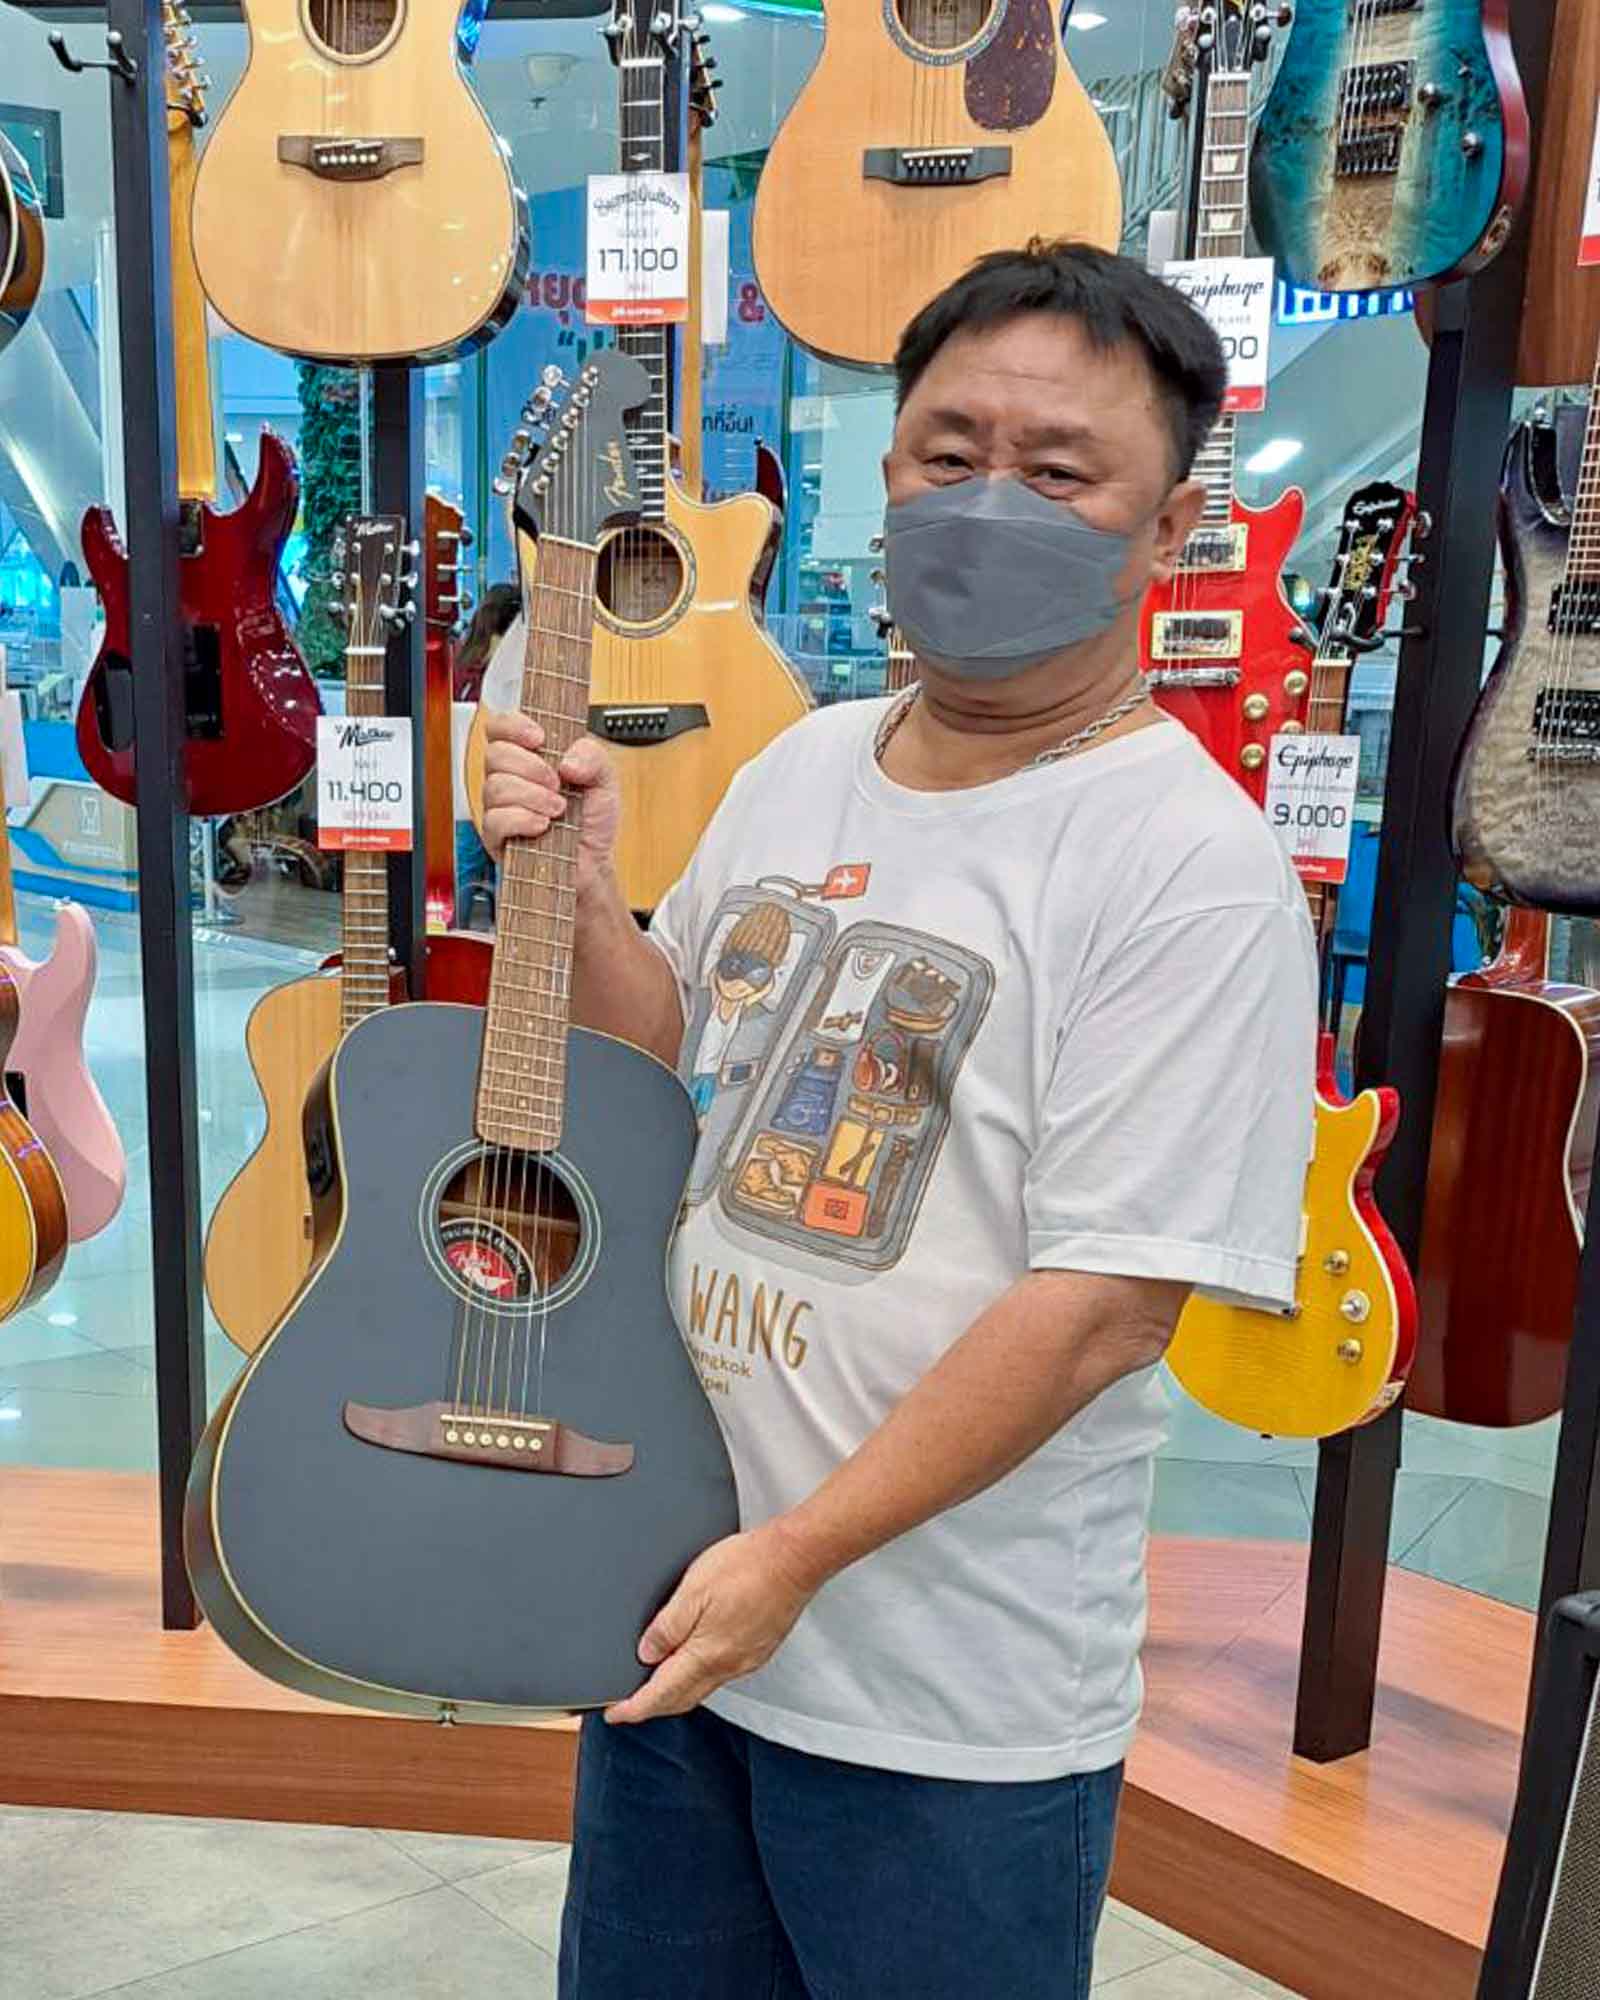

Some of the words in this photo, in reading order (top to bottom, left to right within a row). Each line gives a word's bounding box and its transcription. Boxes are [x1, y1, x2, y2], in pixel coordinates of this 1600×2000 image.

[599, 248, 678, 272] 17.100
[738, 282, 765, 323] &
[1220, 336, 1258, 360] 00
[328, 780, 402, 803] 11.400
[1273, 802, 1347, 829] 9.000
[689, 1262, 815, 1370] WANG
